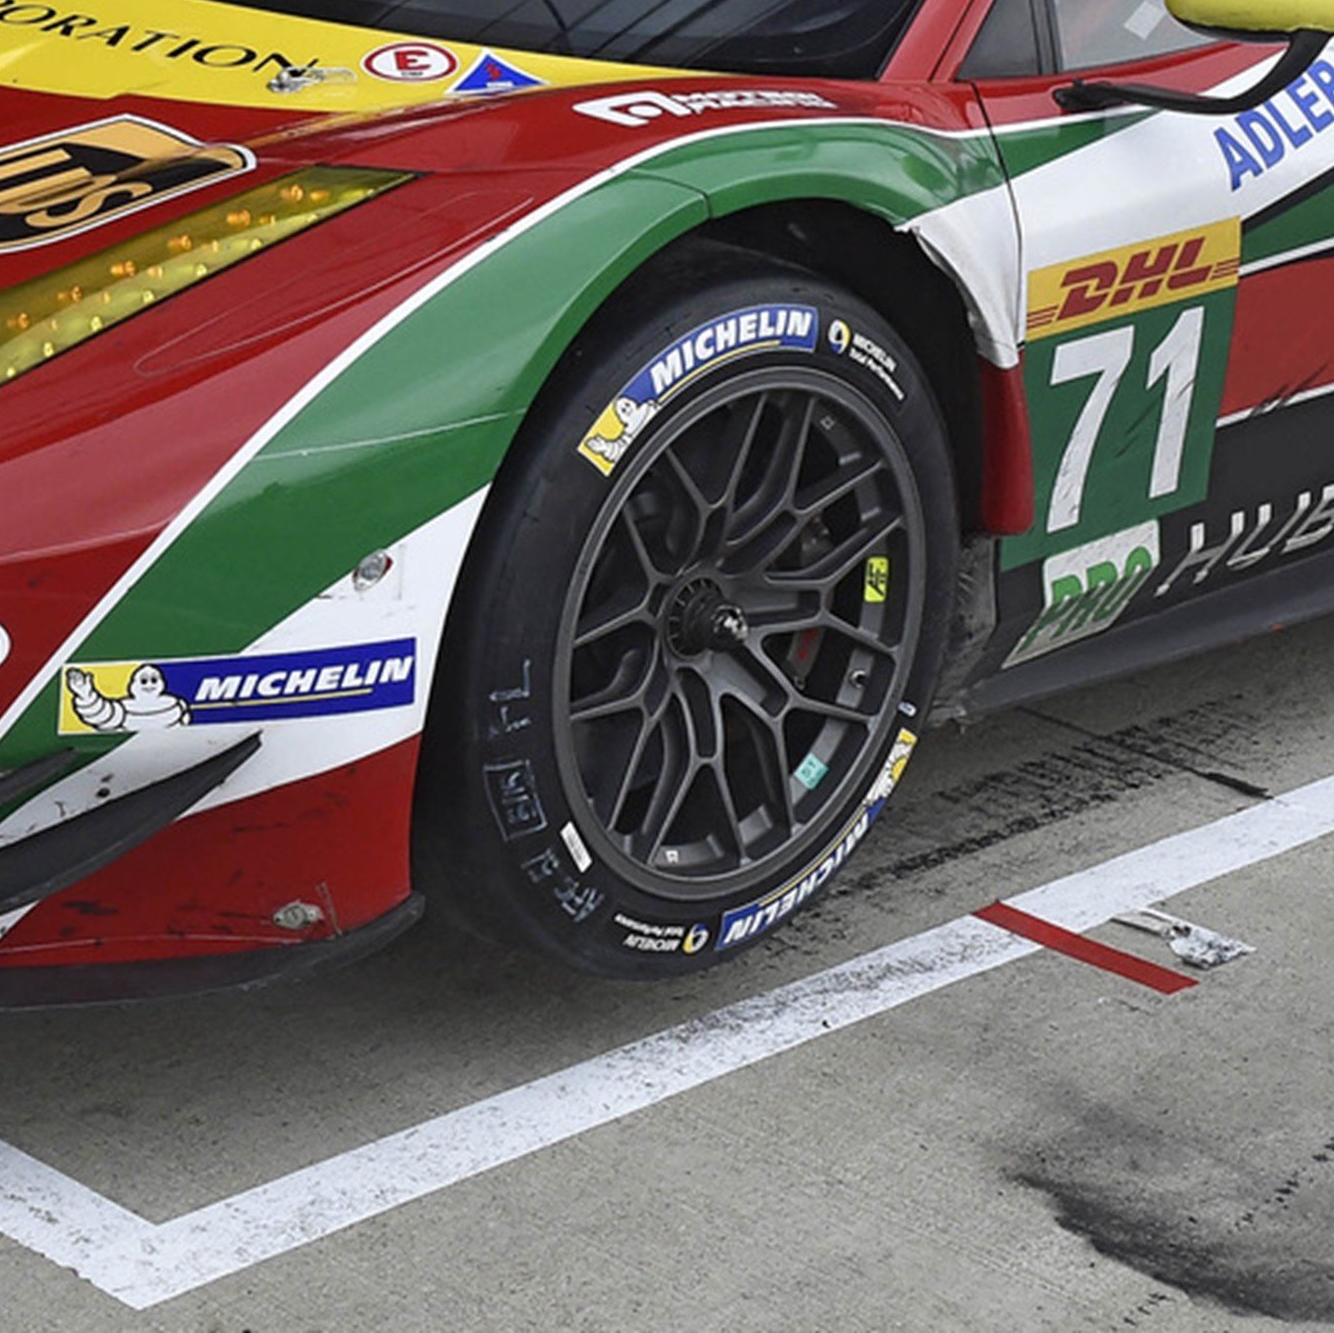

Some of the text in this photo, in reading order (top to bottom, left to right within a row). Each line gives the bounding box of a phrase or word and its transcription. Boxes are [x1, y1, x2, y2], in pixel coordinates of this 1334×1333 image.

[394, 50, 431, 71] E
[1057, 237, 1213, 321] DHL
[649, 308, 813, 394] MICHELIN
[852, 333, 897, 373] MICHELIN
[1047, 306, 1205, 534] 71
[1023, 546, 1154, 651] PRO
[195, 655, 414, 703] MICHELIN
[723, 812, 868, 945] MICHELIN
[624, 933, 680, 952] MICHELIN
